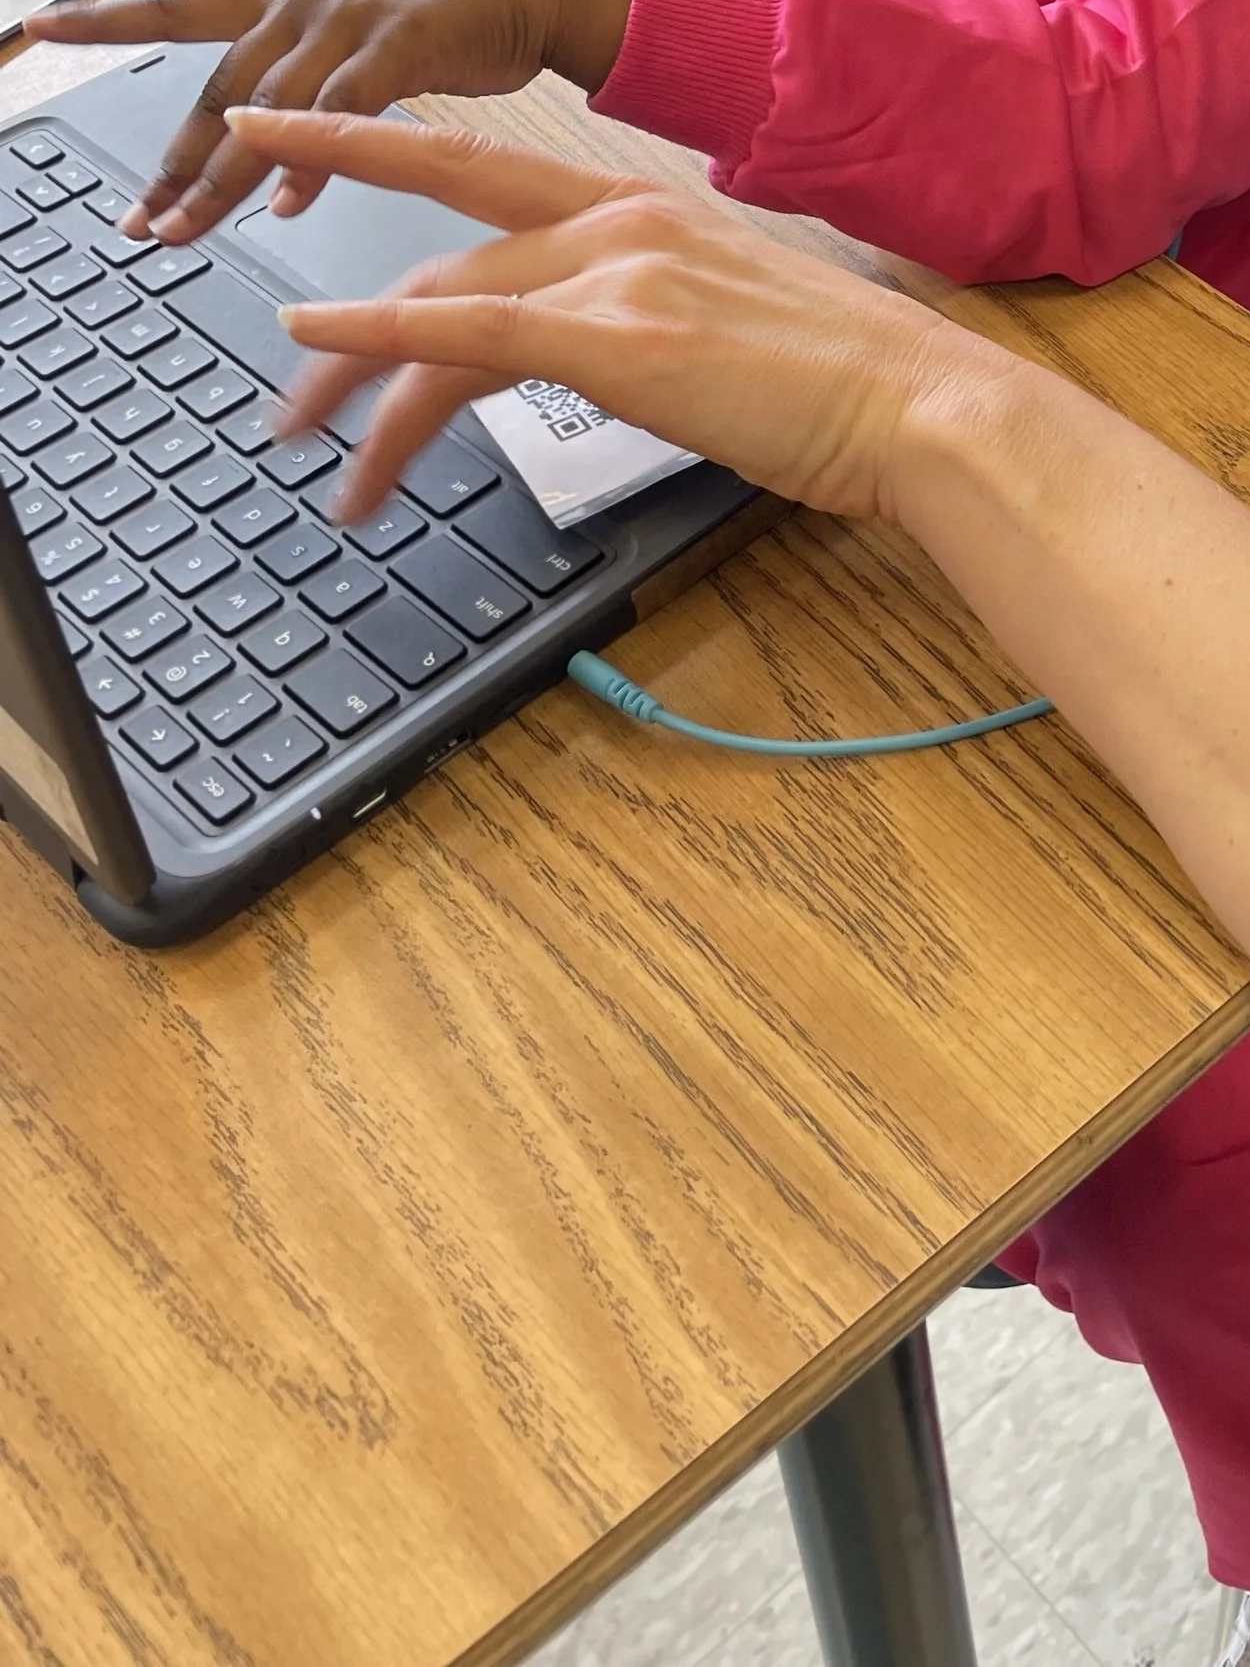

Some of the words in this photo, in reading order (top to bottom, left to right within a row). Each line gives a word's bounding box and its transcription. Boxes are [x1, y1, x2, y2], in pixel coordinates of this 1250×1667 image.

[170, 355, 186, 367] n
[209, 387, 225, 400] b
[125, 407, 141, 421] h
[27, 418, 43, 430] u
[249, 420, 263, 430] v
[163, 438, 184, 451] g
[65, 451, 86, 464] y
[291, 452, 305, 463] c
[451, 480, 469, 494] alt
[25, 502, 43, 514] 6
[242, 509, 262, 520] d
[378, 520, 394, 532] z
[65, 537, 83, 550] 5
[290, 545, 305, 556] s
[187, 557, 202, 569] e
[545, 553, 571, 571] ctrl
[105, 574, 122, 585] 4
[335, 581, 350, 593] a
[228, 594, 247, 610] w
[475, 597, 504, 619] shift
[148, 611, 166, 625] 3
[274, 630, 291, 646] q
[192, 650, 211, 664] 2
[165, 665, 187, 682] @
[237, 692, 253, 704] 1
[346, 695, 368, 714] tab
[202, 776, 225, 797] esc
